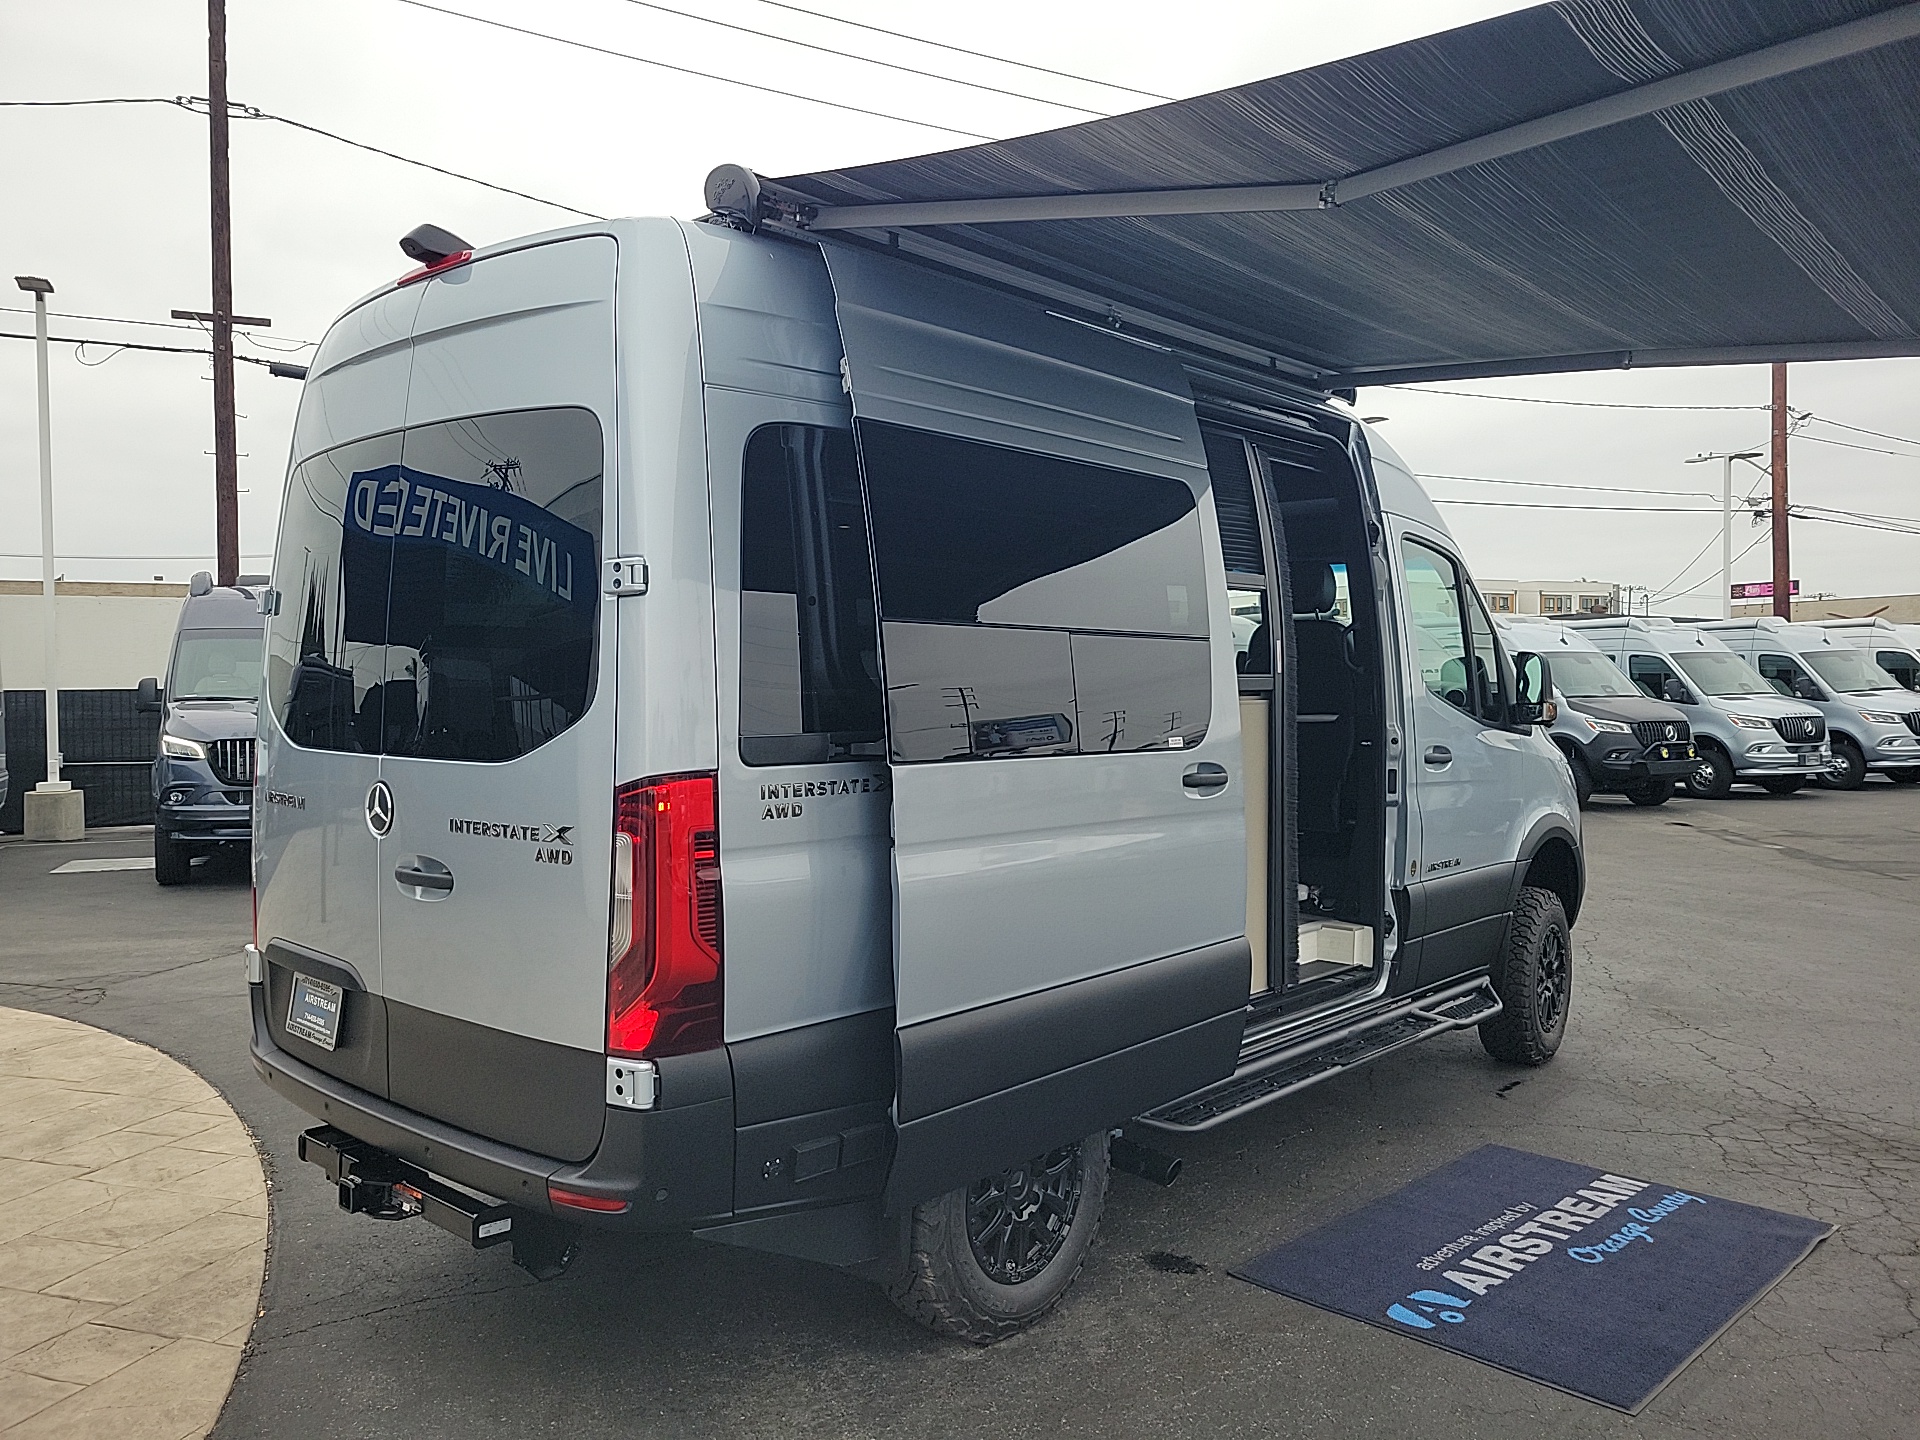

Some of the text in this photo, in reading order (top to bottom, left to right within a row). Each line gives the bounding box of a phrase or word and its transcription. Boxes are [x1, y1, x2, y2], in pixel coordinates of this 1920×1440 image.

[761, 802, 803, 820] AWD
[534, 847, 573, 866] AWD
[304, 993, 337, 1013] AIRSTREAM
[1508, 1201, 1538, 1213] by
[1441, 1173, 1651, 1296] AIRSTREAM
[1566, 1190, 1707, 1263] Orange County
